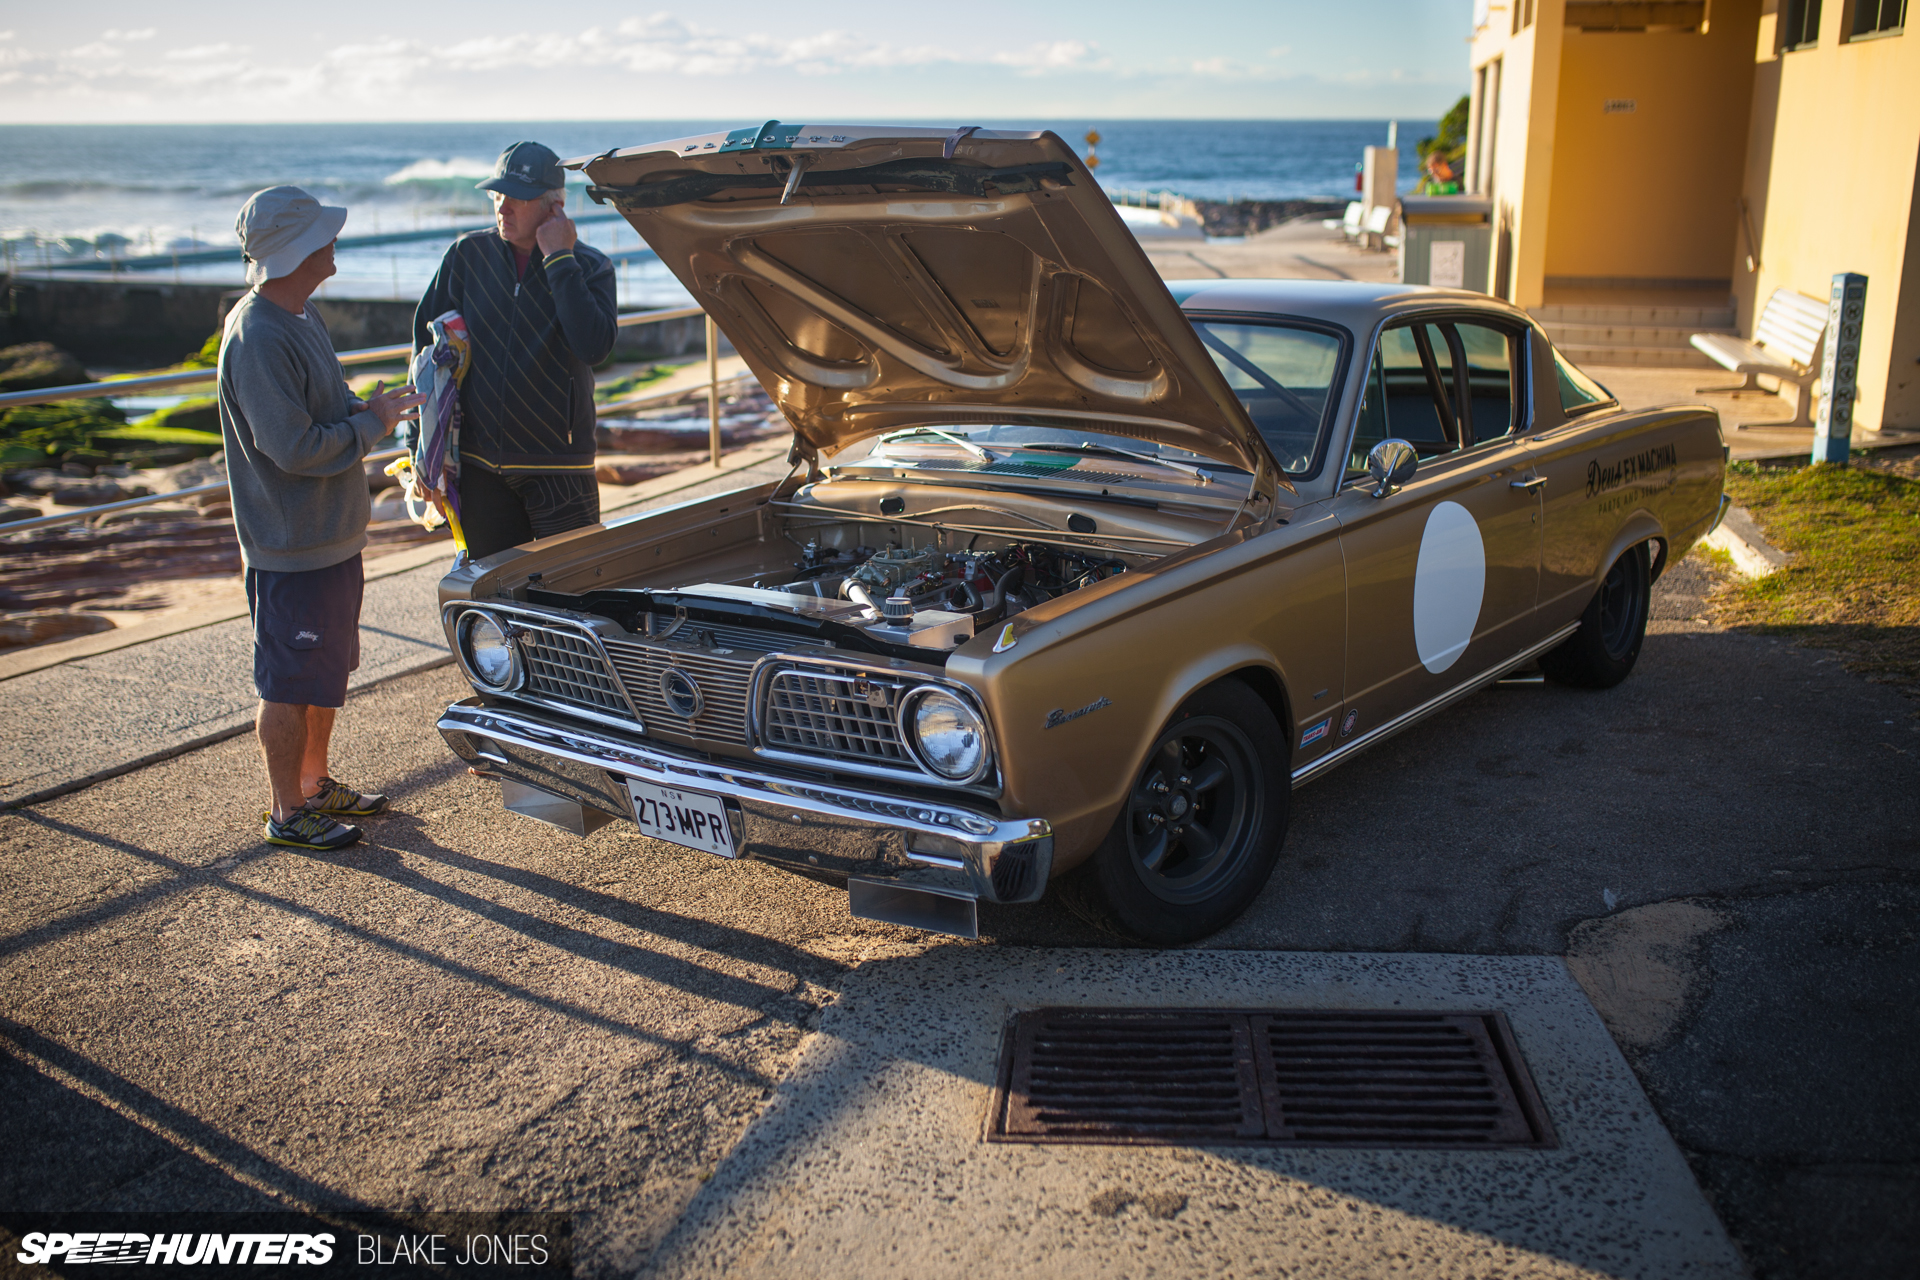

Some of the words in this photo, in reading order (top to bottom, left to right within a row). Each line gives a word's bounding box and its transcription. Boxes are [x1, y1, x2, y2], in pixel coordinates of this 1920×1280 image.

[684, 134, 845, 152] PLYMOUTH
[1586, 458, 1622, 499] Deus
[1623, 456, 1637, 485] EX
[1637, 443, 1677, 479] MACHINA
[1598, 497, 1621, 515] PARTS
[1623, 490, 1639, 506] AND
[660, 789, 682, 801] NSW
